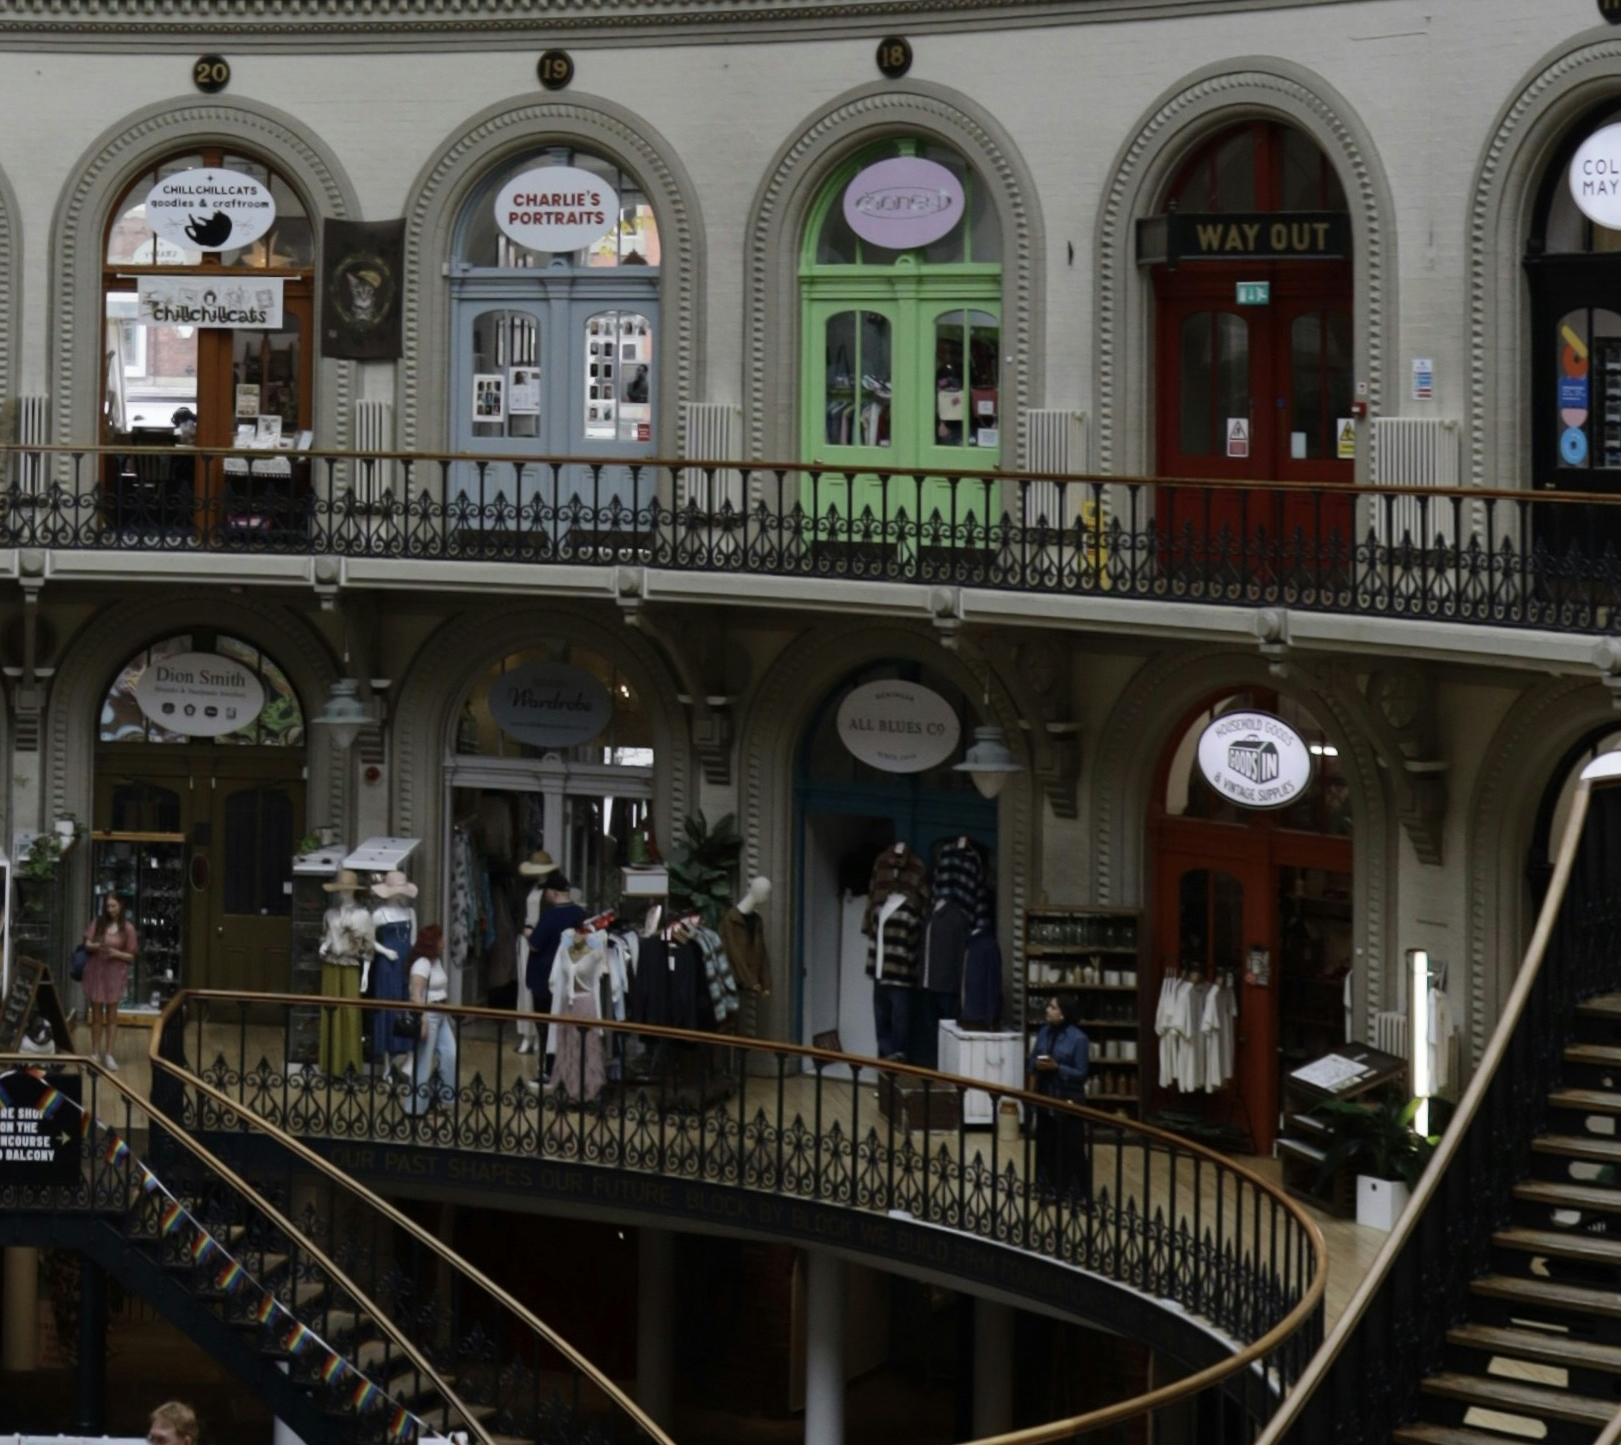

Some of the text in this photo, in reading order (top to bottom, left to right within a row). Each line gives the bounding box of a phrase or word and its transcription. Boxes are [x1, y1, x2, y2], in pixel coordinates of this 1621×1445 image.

[881, 45, 905, 68] 18
[196, 63, 228, 83] 20
[542, 59, 568, 79] 19
[162, 185, 258, 195] CHILLCHILLCATS
[513, 190, 601, 207] CHARLIE'S
[150, 198, 269, 209] goodies & craftroom
[508, 211, 604, 225] PORTRAITS
[1196, 222, 1330, 251] WAY OUT
[153, 305, 267, 324] chillchillcats
[156, 666, 246, 688] Dion Smith
[508, 687, 593, 712] Wardrobe
[849, 717, 875, 731] ALL
[878, 719, 923, 734] BLUES
[1215, 718, 1294, 747] HOUSEHOLD GOODS
[1228, 748, 1279, 784] GOODS IN
[1223, 777, 1255, 802] VINTAGE
[1258, 780, 1296, 803] SUPPLIES
[0, 1121, 39, 1133] ON THE
[5, 1149, 56, 1162] BALCONY
[331, 1148, 377, 1172] OUR
[384, 1151, 436, 1177] PAST
[446, 1157, 533, 1189] SHAPES
[541, 1166, 584, 1192] OUR
[592, 1173, 673, 1206] FUTURE
[685, 1189, 751, 1220] BLOCK
[759, 1200, 782, 1224] BY
[792, 1207, 854, 1238] BLOCK
